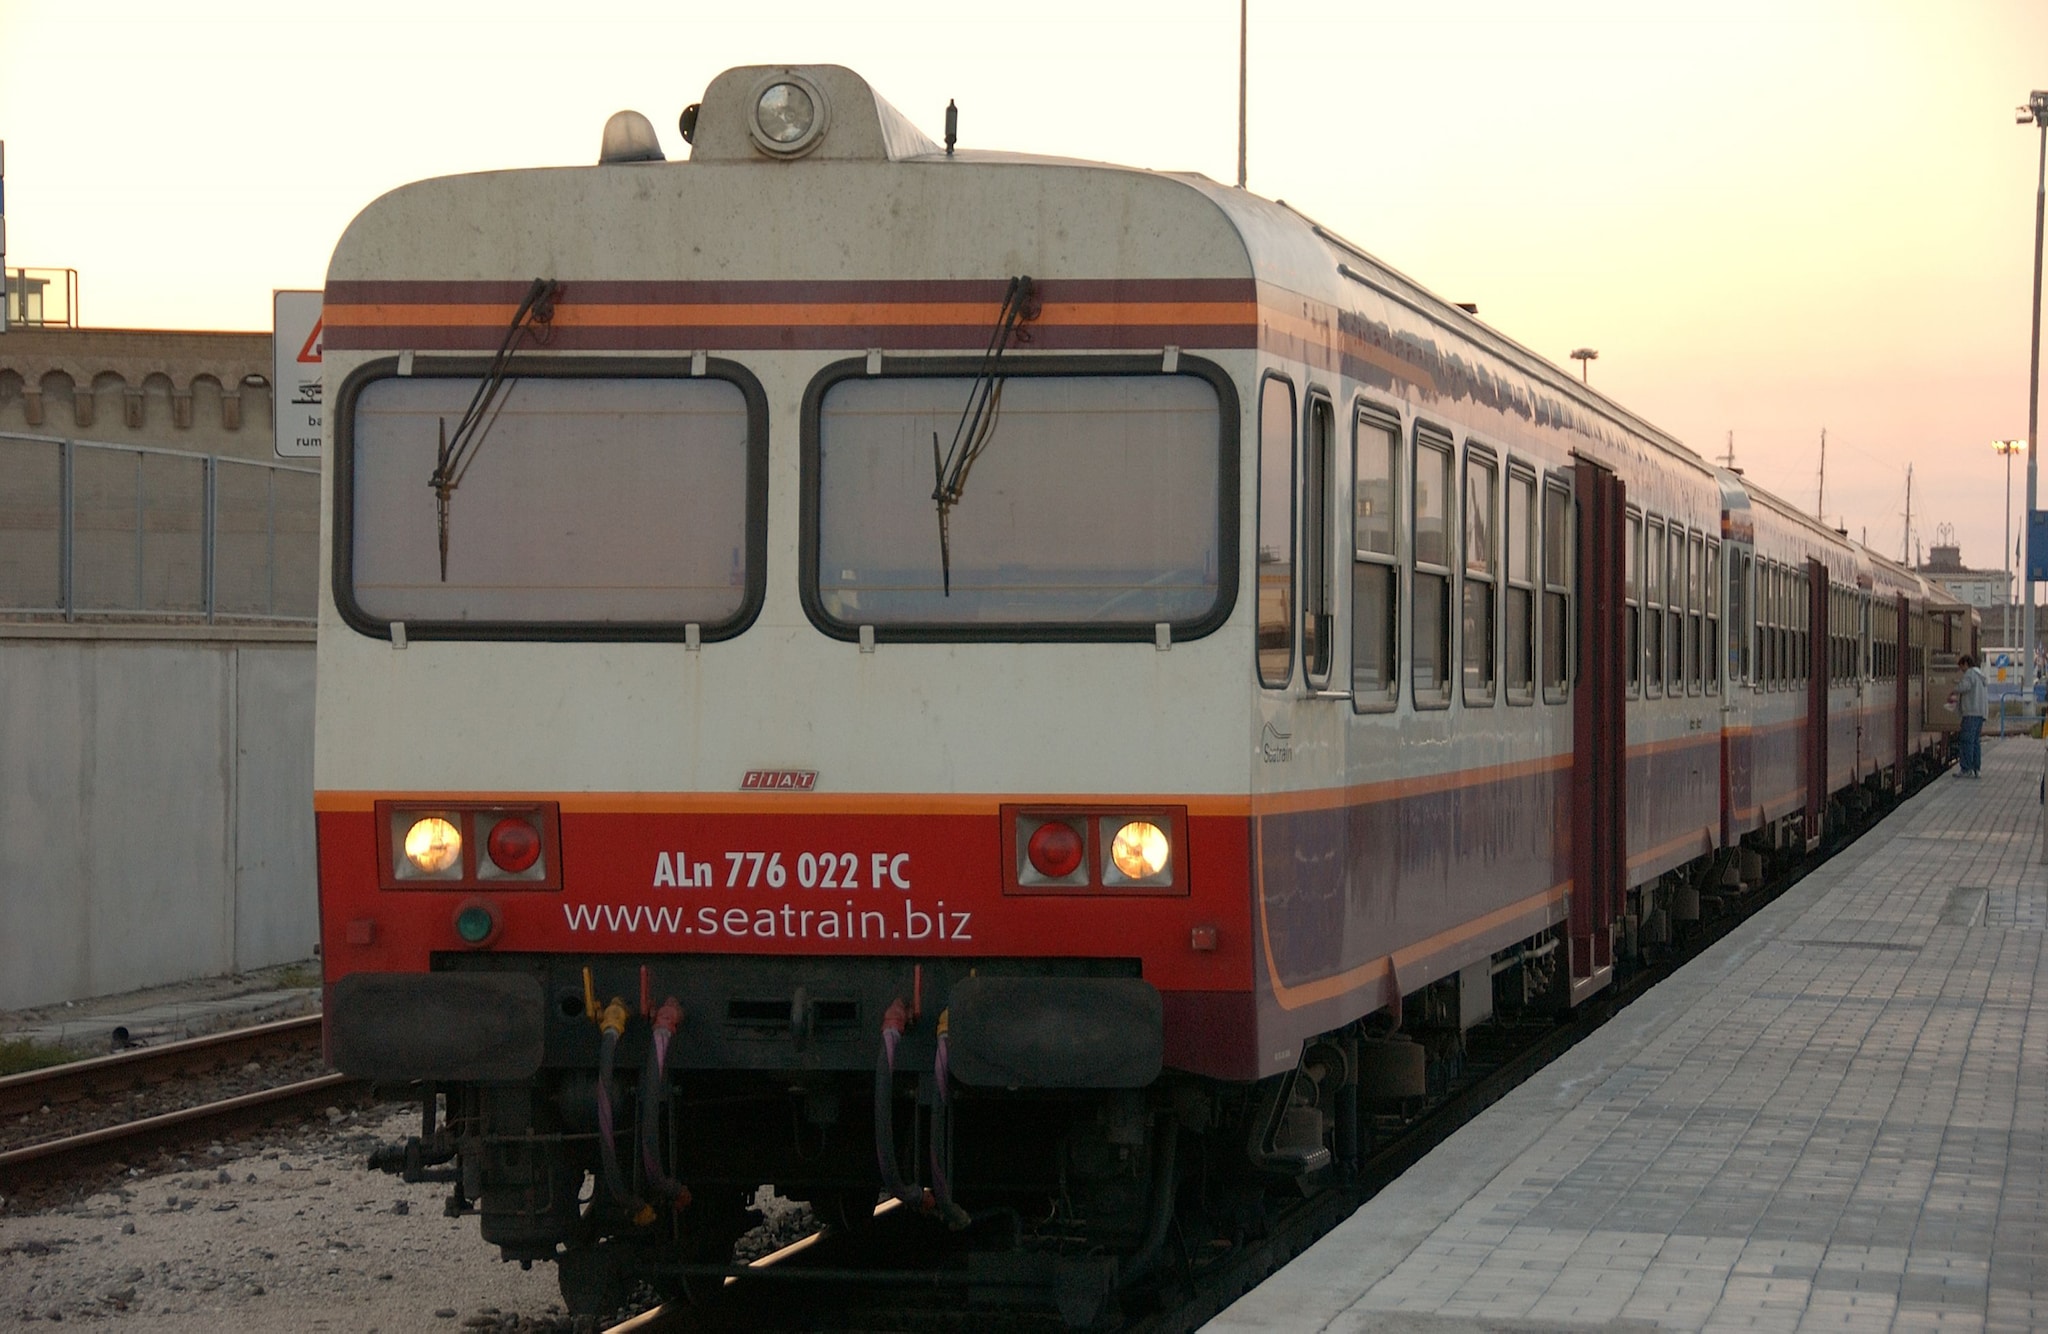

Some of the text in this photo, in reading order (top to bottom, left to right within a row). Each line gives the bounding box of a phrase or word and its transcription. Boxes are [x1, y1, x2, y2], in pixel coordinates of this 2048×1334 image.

[745, 772, 812, 787] FIAT
[653, 851, 911, 889] ALn 776 022 FC
[563, 898, 973, 940] www.seatrain.biz
